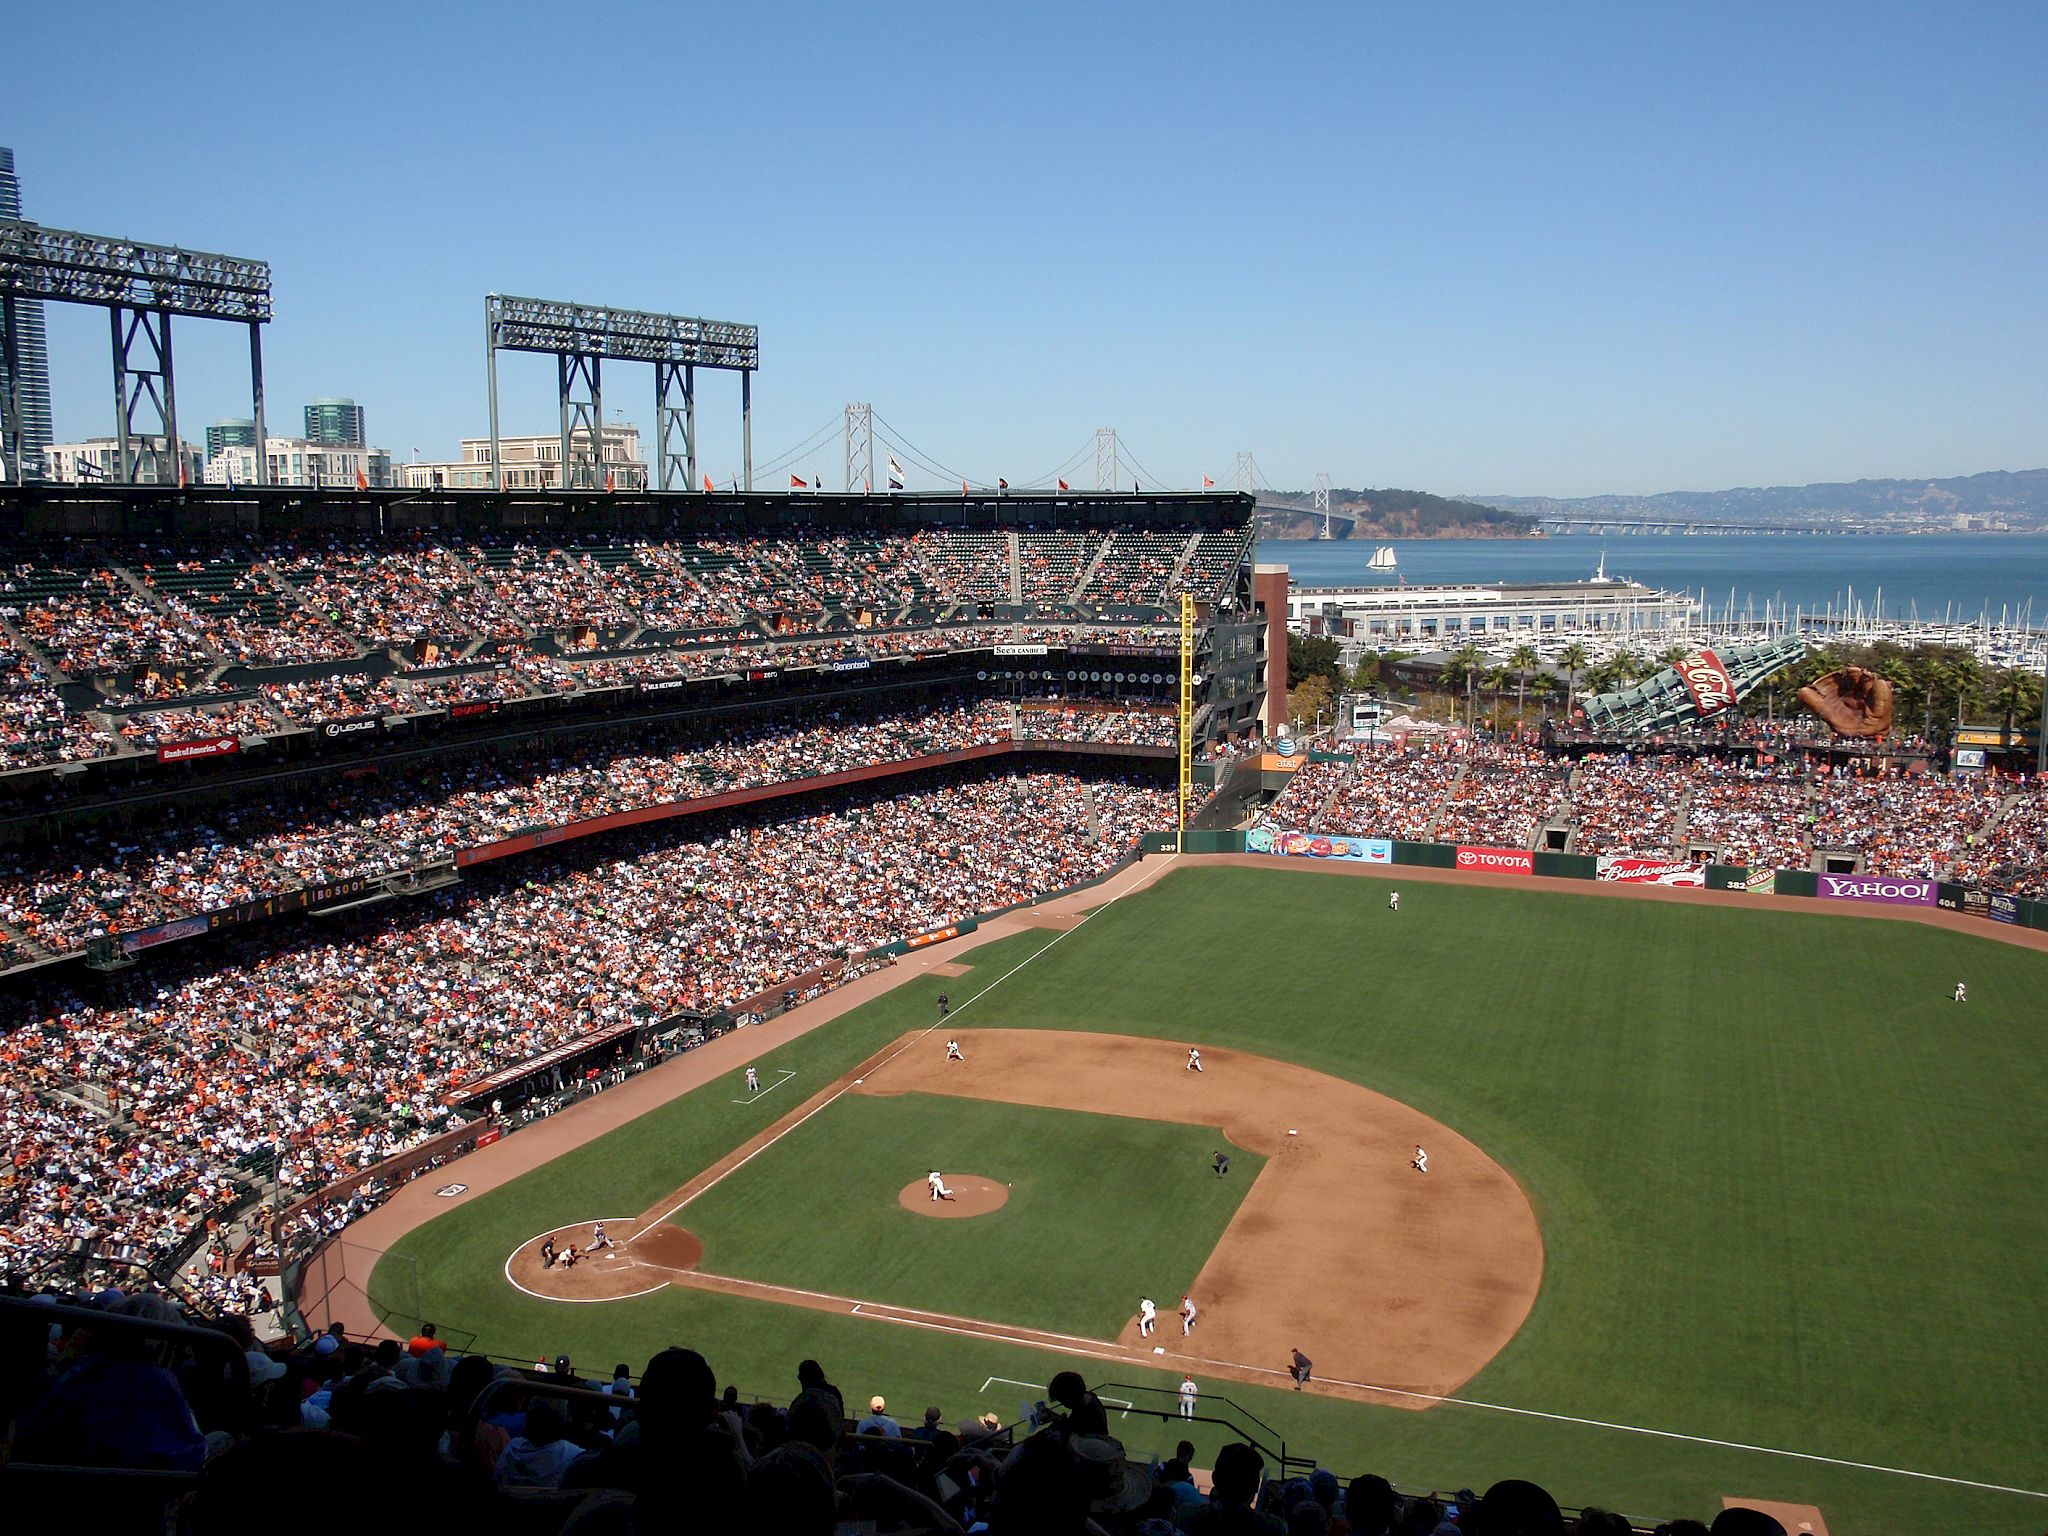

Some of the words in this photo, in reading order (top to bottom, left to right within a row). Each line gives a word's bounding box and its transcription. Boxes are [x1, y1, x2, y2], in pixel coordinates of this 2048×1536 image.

[832, 659, 870, 672] Genentech
[1687, 668, 1732, 710] Cola
[451, 703, 488, 717] SHARP
[340, 720, 375, 733] LEXUS
[164, 748, 182, 758] Bank
[190, 745, 216, 755] America
[1277, 759, 1296, 768] at&t
[1160, 844, 1176, 852] 339
[1478, 853, 1531, 868] TOYOTA
[1601, 860, 1692, 881] Budweiser
[1746, 869, 1775, 886] EMERALD
[1727, 881, 1746, 890] 382
[1822, 877, 1930, 901] YAHOO!
[1938, 898, 1956, 909] 404
[166, 924, 194, 939] LIGHT
